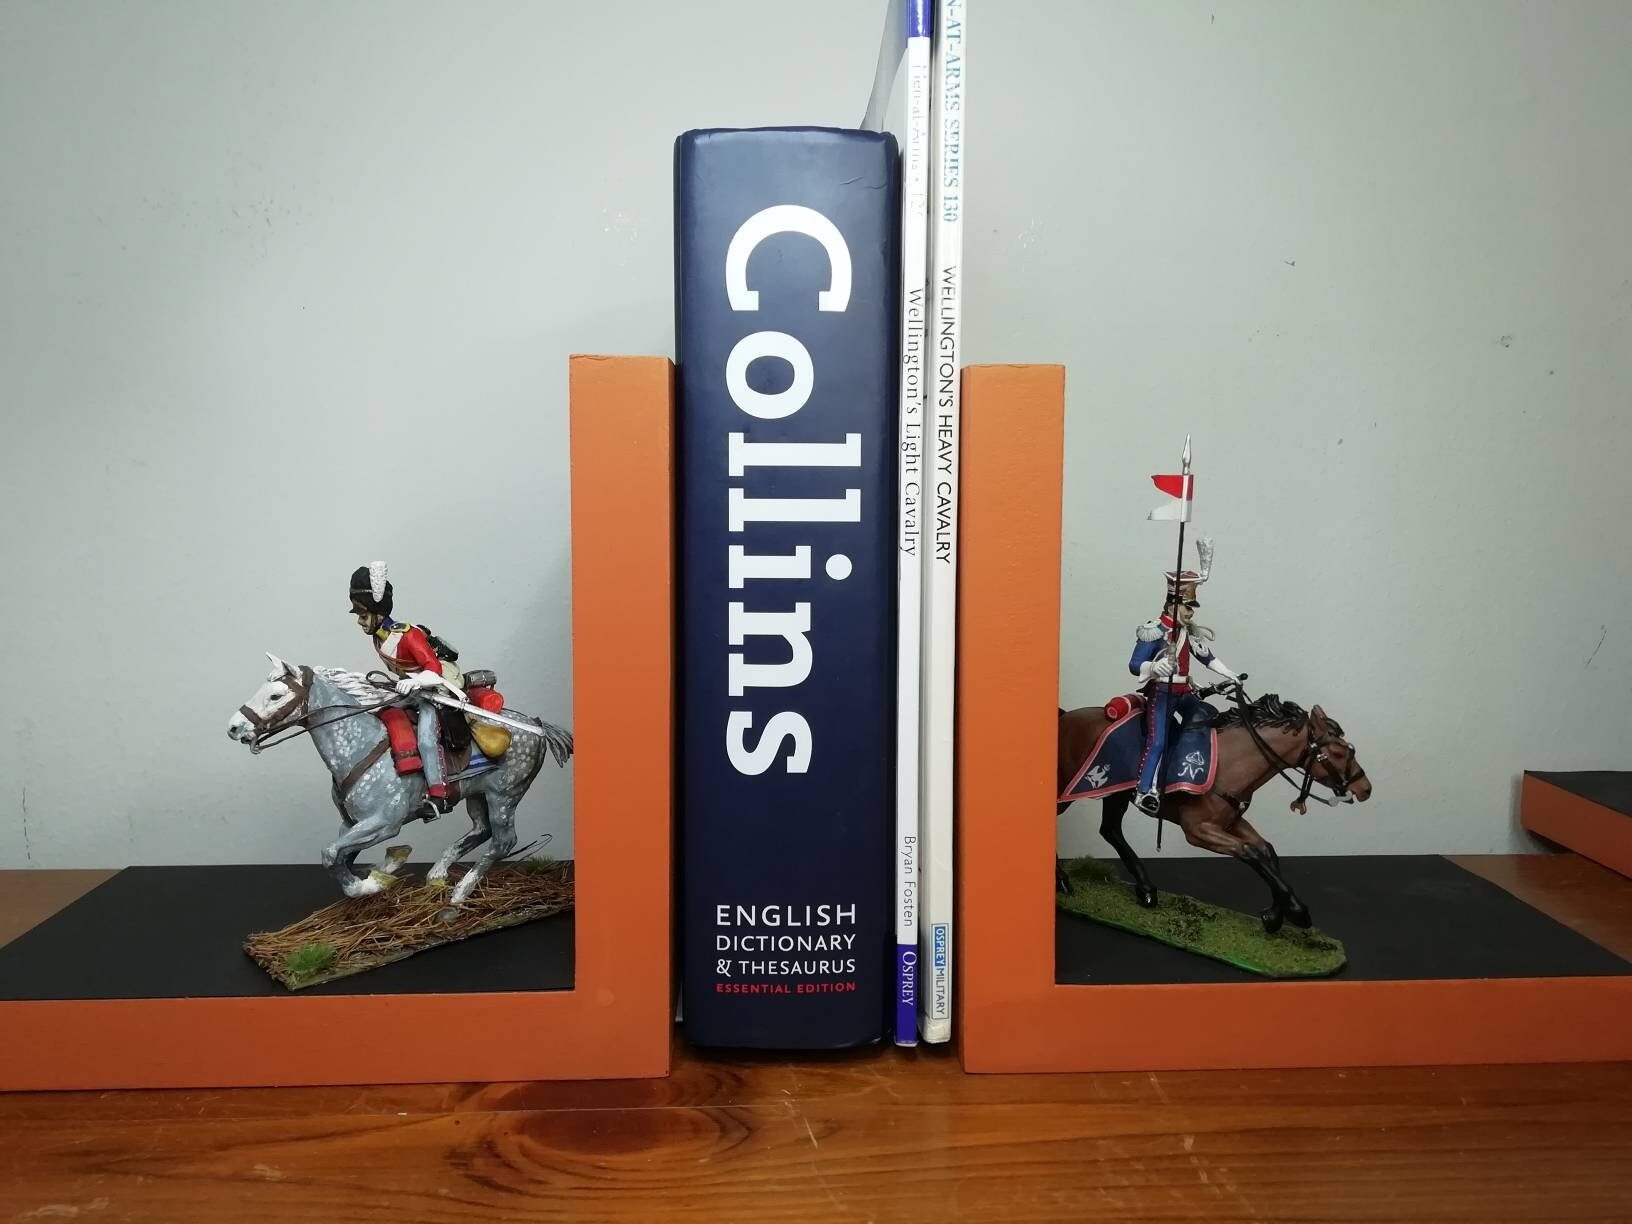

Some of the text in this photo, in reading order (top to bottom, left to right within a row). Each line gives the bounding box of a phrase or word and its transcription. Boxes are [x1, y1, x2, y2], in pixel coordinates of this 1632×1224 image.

[944, 118, 960, 188] SERIES
[944, 194, 960, 223] 130
[900, 288, 923, 556] Wellington's Light Cavalry
[936, 265, 957, 564] WELLINGTON'S HEAVY CAVALRY
[725, 204, 861, 776] Collins
[716, 904, 856, 926] ENGLISH
[903, 836, 916, 927] Bryan Fosten
[716, 934, 856, 951] DICTIONARY
[716, 959, 856, 977] & THESAURUS
[934, 927, 947, 1015] OSPREY MILITARY
[716, 982, 856, 993] ESSENTIAL EDITION
